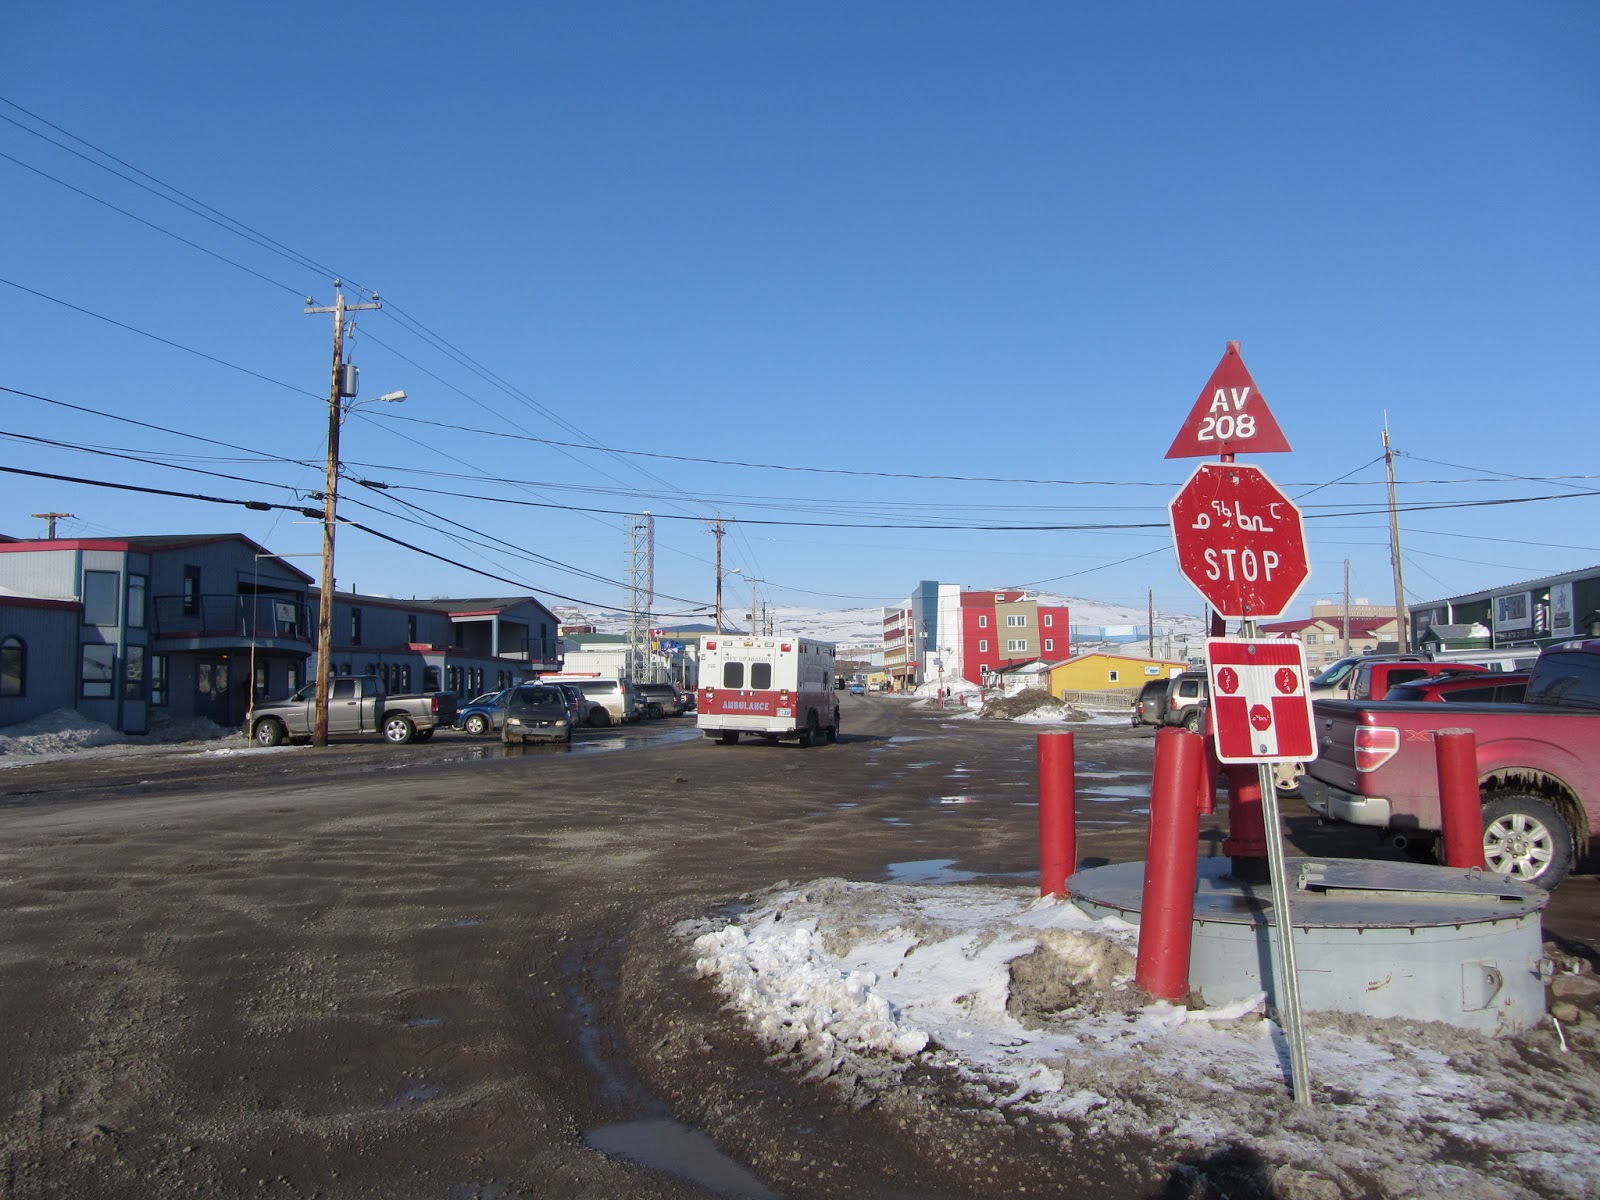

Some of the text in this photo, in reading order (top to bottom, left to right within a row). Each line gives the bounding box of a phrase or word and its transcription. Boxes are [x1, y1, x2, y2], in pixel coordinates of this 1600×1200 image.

[1209, 386, 1250, 412] AV
[1197, 413, 1256, 441] 208
[1203, 547, 1279, 582] STOP
[722, 700, 770, 711] AMBULANCE
